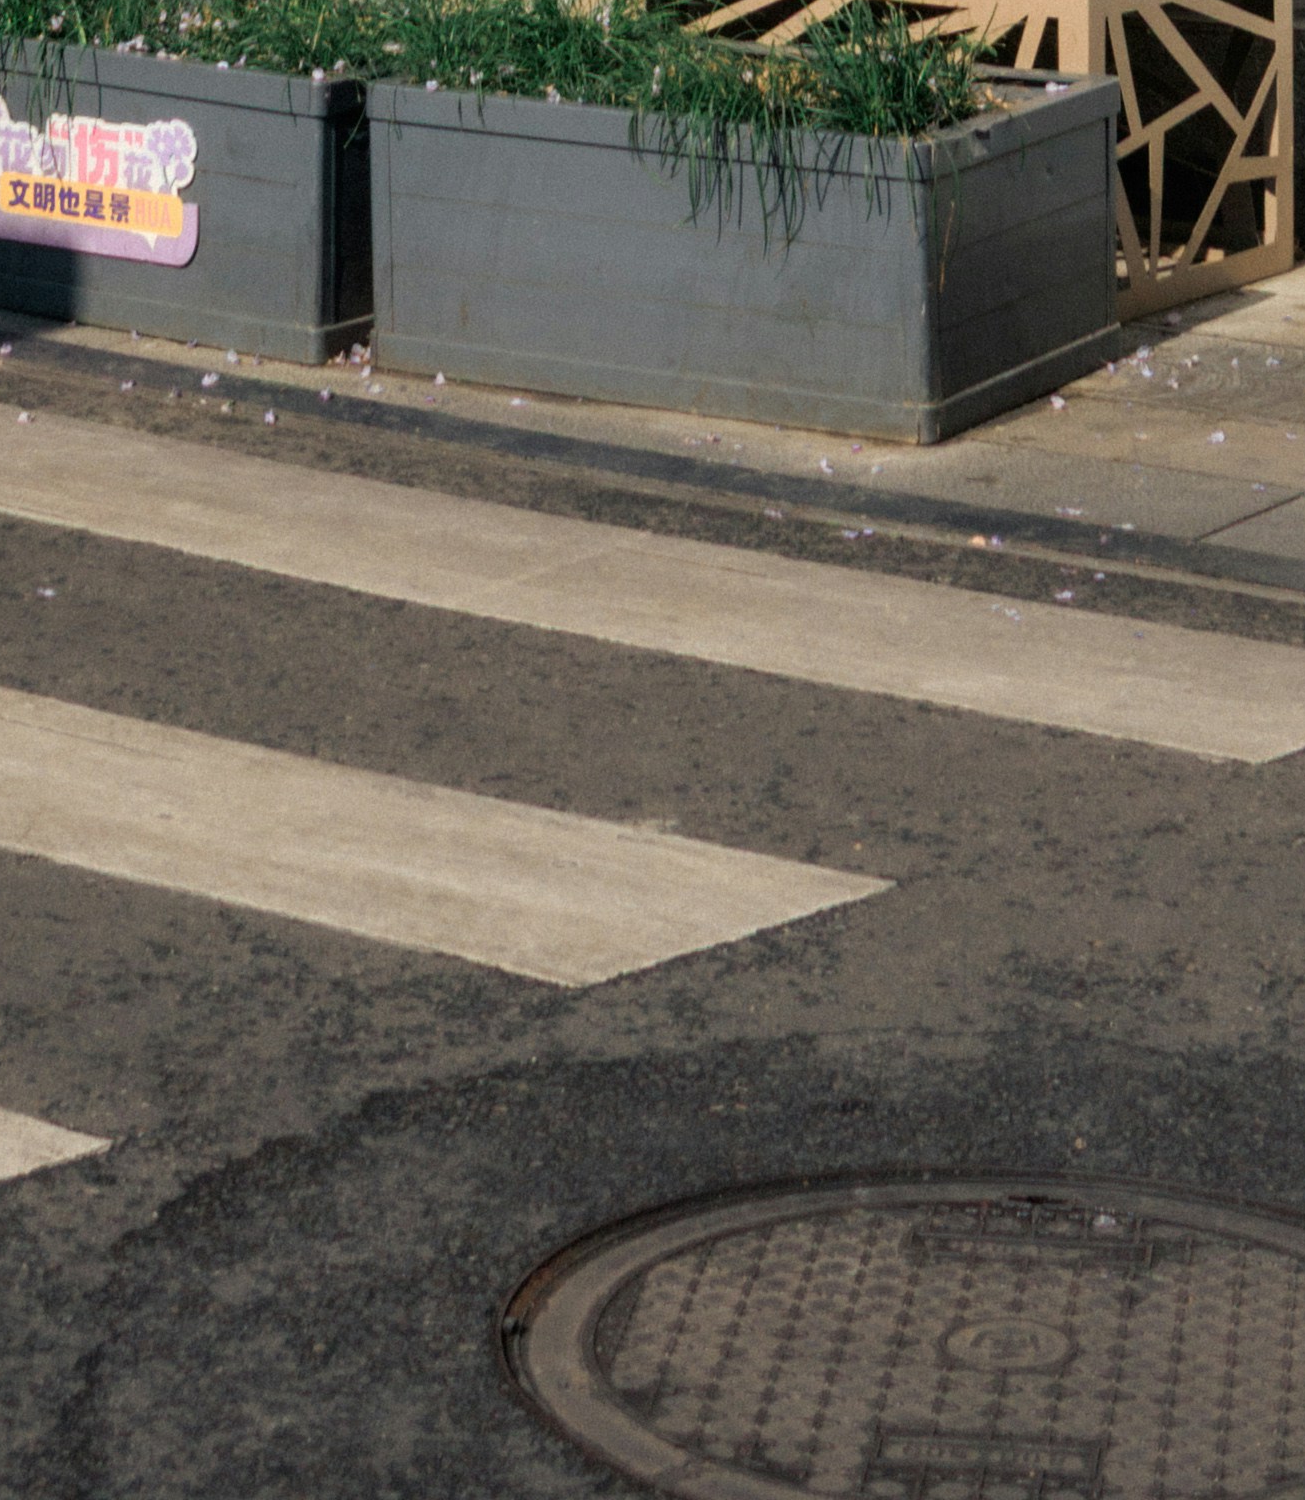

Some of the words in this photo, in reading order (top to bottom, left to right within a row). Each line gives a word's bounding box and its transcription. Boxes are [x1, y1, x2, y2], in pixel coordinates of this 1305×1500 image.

[9, 178, 131, 224] 文明也是景
